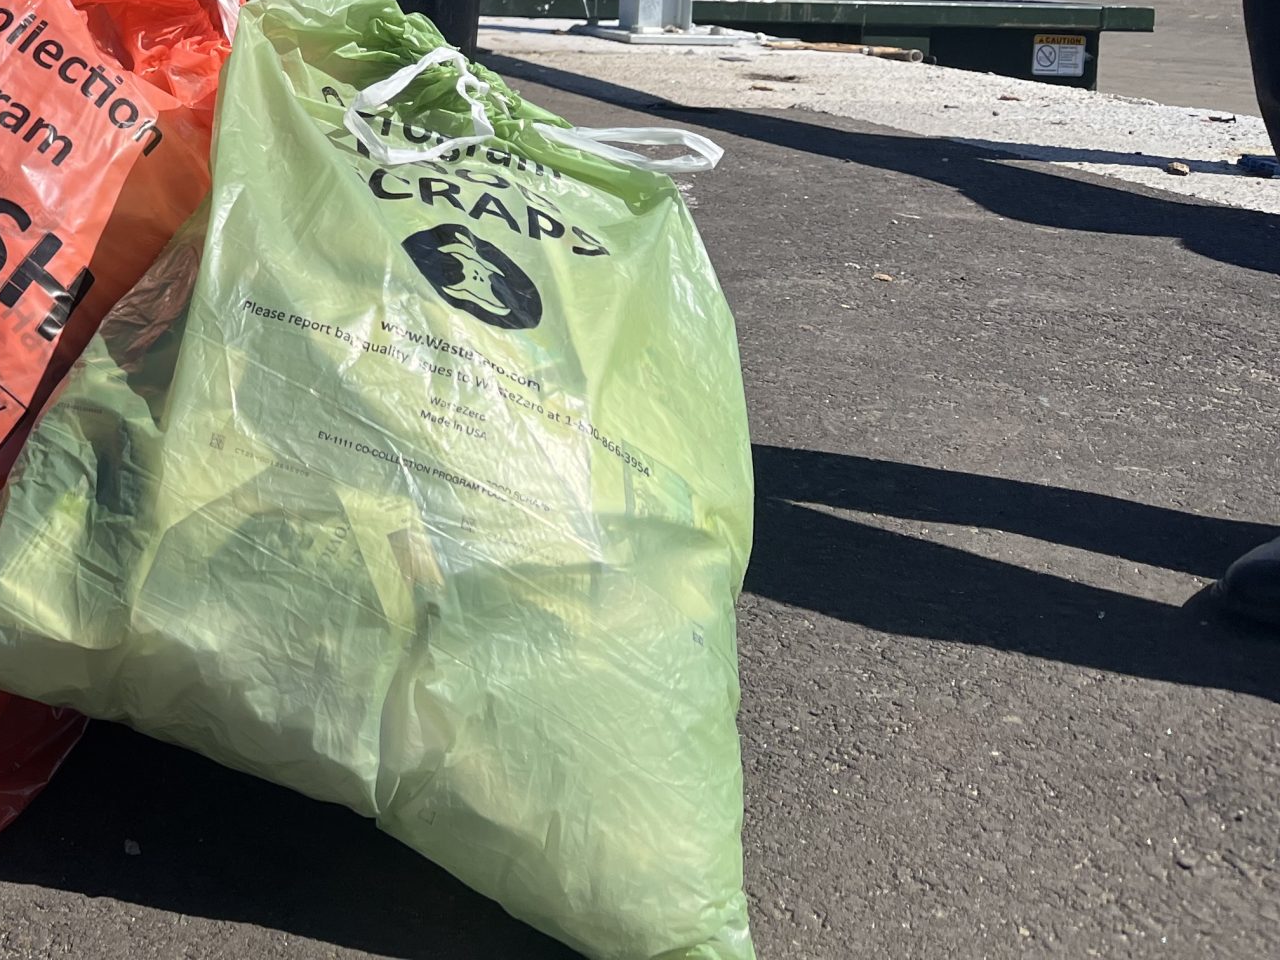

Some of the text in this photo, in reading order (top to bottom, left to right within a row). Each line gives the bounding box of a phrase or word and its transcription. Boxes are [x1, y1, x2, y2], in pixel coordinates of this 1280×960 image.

[1044, 36, 1082, 45] CAUTION
[354, 168, 610, 257] CRAPS
[242, 300, 286, 321] Please
[288, 313, 333, 336] report
[335, 326, 360, 347] ba
[362, 340, 409, 364] quality
[547, 410, 561, 423] at
[432, 468, 480, 493] PROGRAM
